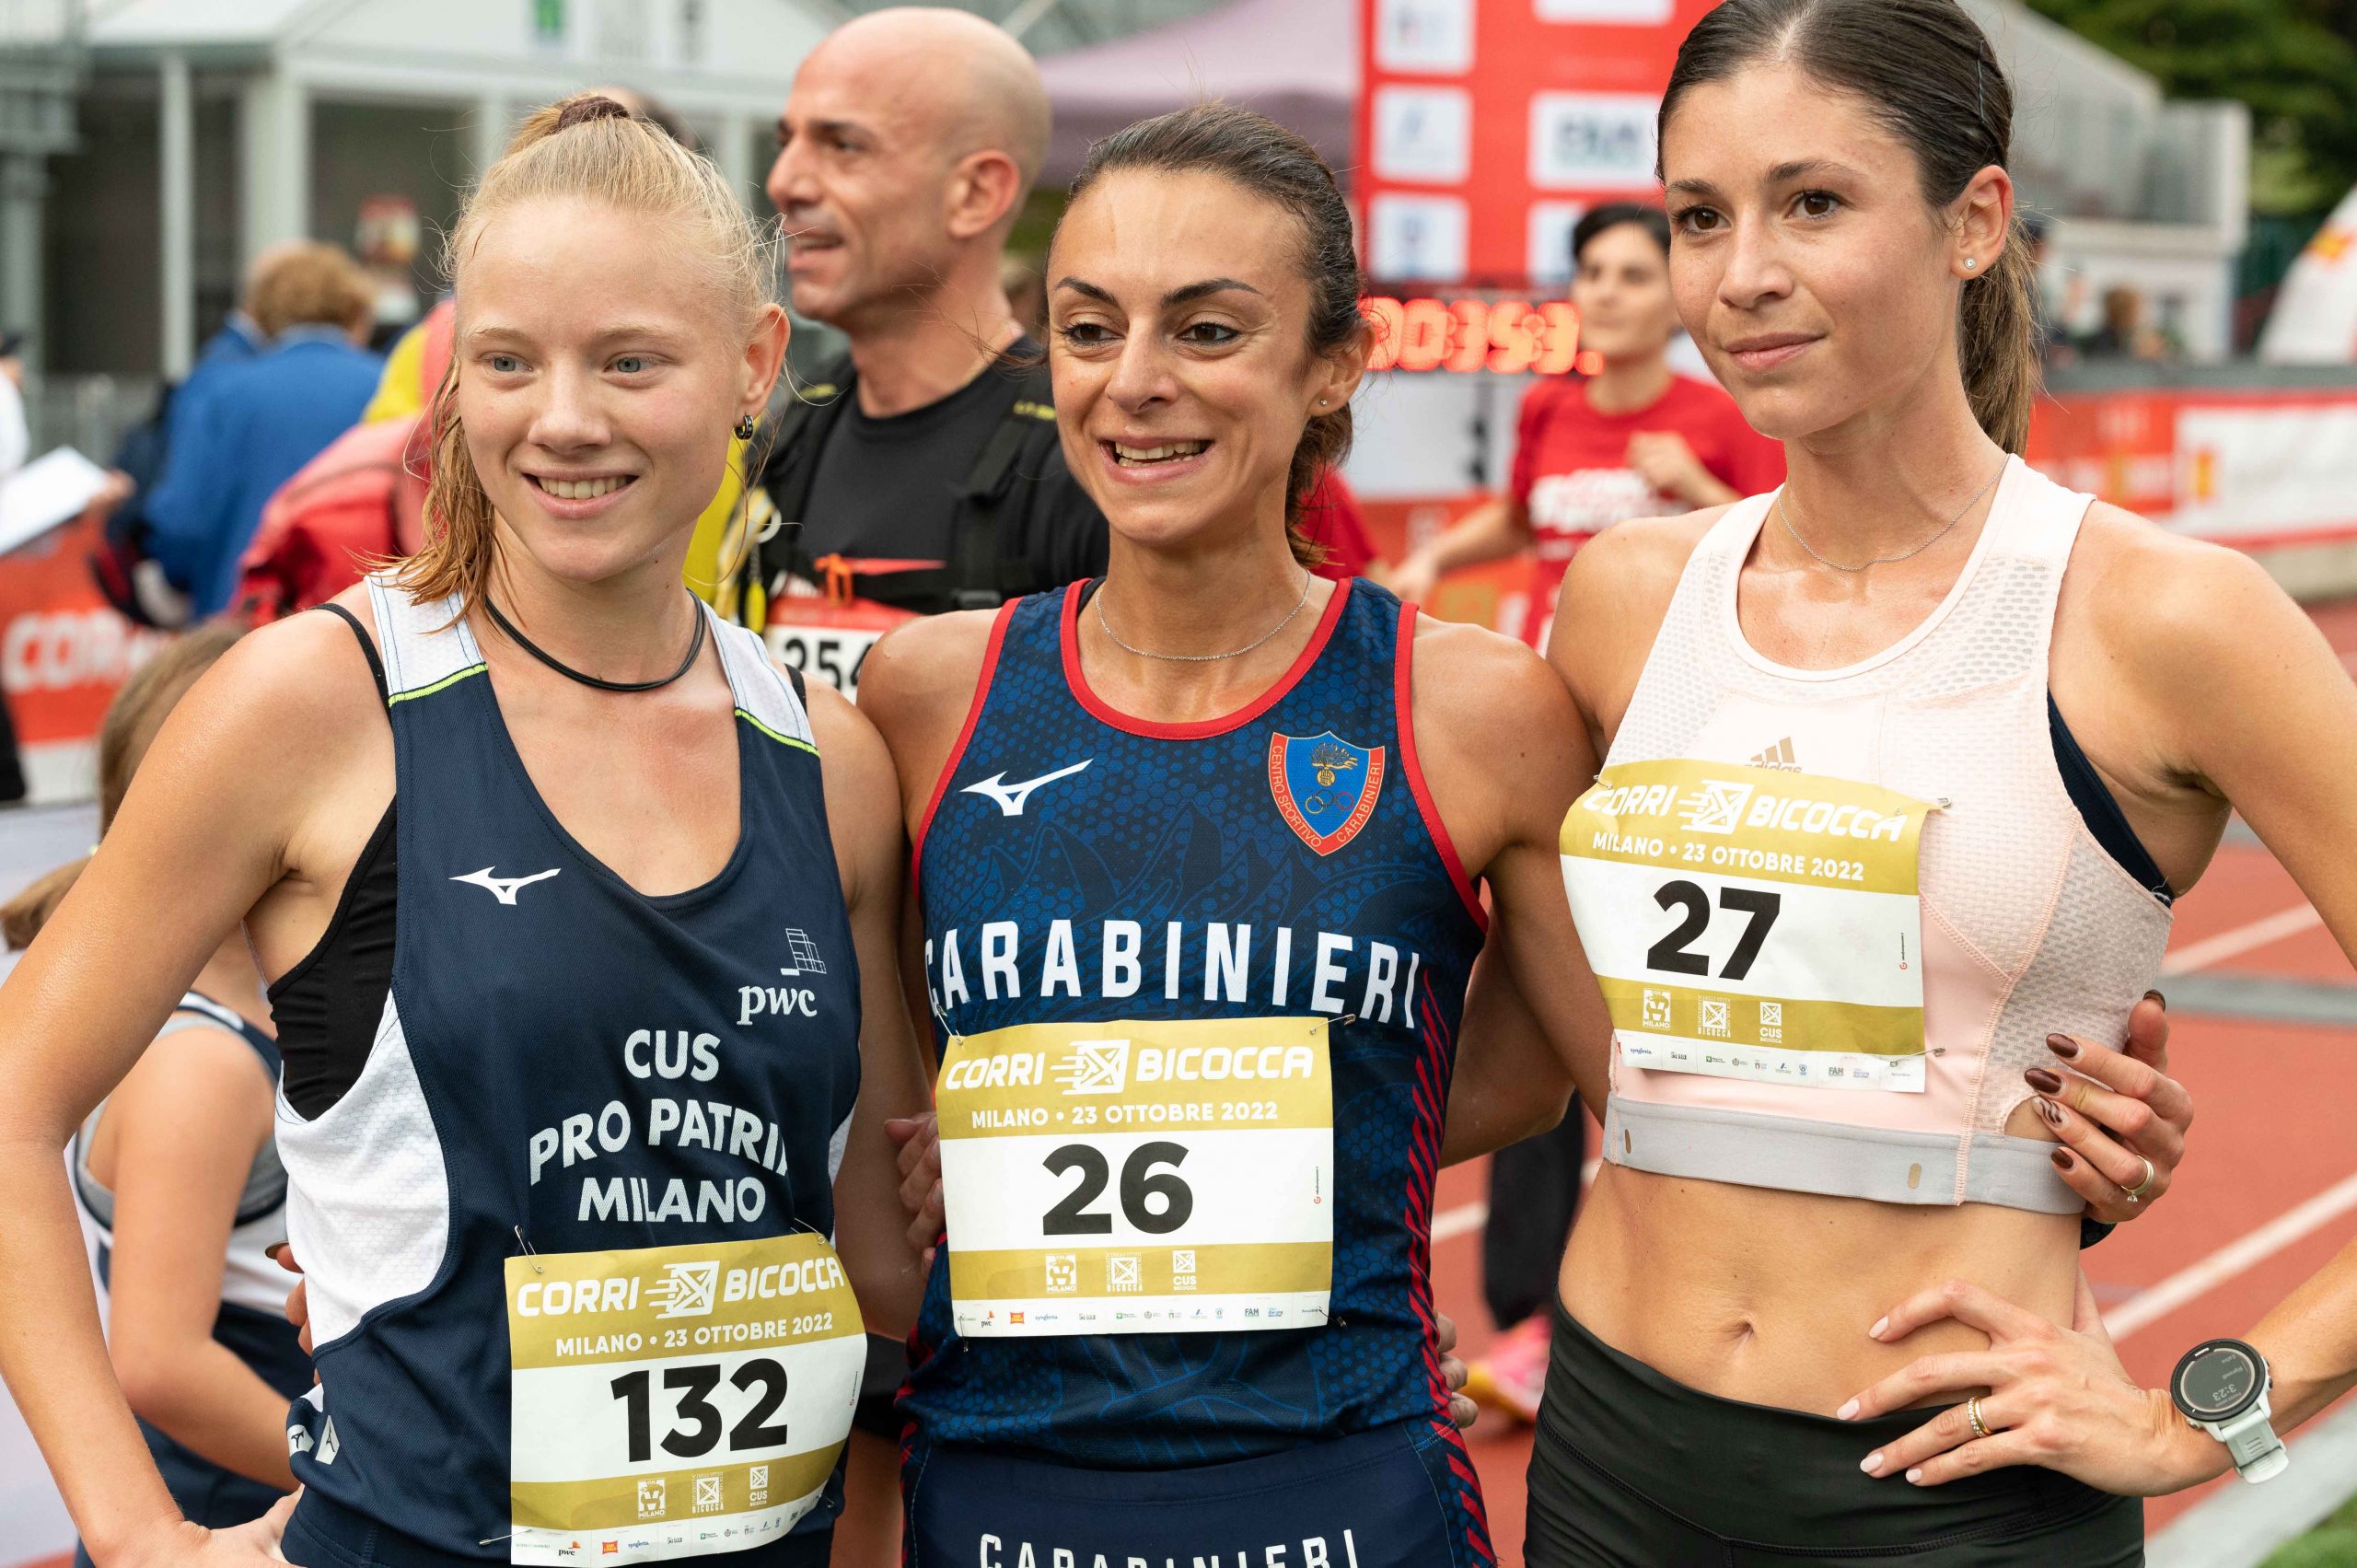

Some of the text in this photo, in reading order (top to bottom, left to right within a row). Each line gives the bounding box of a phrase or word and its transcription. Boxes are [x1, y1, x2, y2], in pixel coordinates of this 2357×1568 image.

[1271, 745, 1322, 847] CENTRO SPORTIVO
[1336, 762, 1381, 842] CARABINIERI
[1582, 785, 1908, 842] CORRI BICOCCA
[1592, 831, 1864, 881] MILANO 23 OTTOBRE 2022
[1646, 879, 1782, 981] 27
[924, 919, 1420, 1028] CARABINIERI
[737, 985, 818, 1026] pwc
[1643, 1019, 1670, 1029] MILANO
[1698, 1027, 1732, 1038] BICOCCA
[1759, 1027, 1782, 1038] CUS
[625, 1029, 722, 1082] CUS
[946, 1046, 1314, 1089] CORRI BICOCCA
[971, 1101, 1278, 1129] MILANO 23 OTTOBRE 2022
[529, 1100, 632, 1186] PRO
[578, 1177, 766, 1223] MILANO
[1042, 1141, 1194, 1236] 26
[517, 1256, 845, 1317] CORRI BICOCCA
[1173, 1275, 1196, 1284] CUS
[556, 1312, 833, 1357] MILANO 23 OTTOBRE 2022
[610, 1358, 789, 1462] 132
[2212, 1384, 2237, 1401] 3:23
[639, 1509, 666, 1518] MILANO
[692, 1502, 725, 1513] BICOCCA
[749, 1490, 768, 1502] CUS
[558, 1549, 575, 1557] pwc
[980, 1528, 1358, 1568] CARERI
